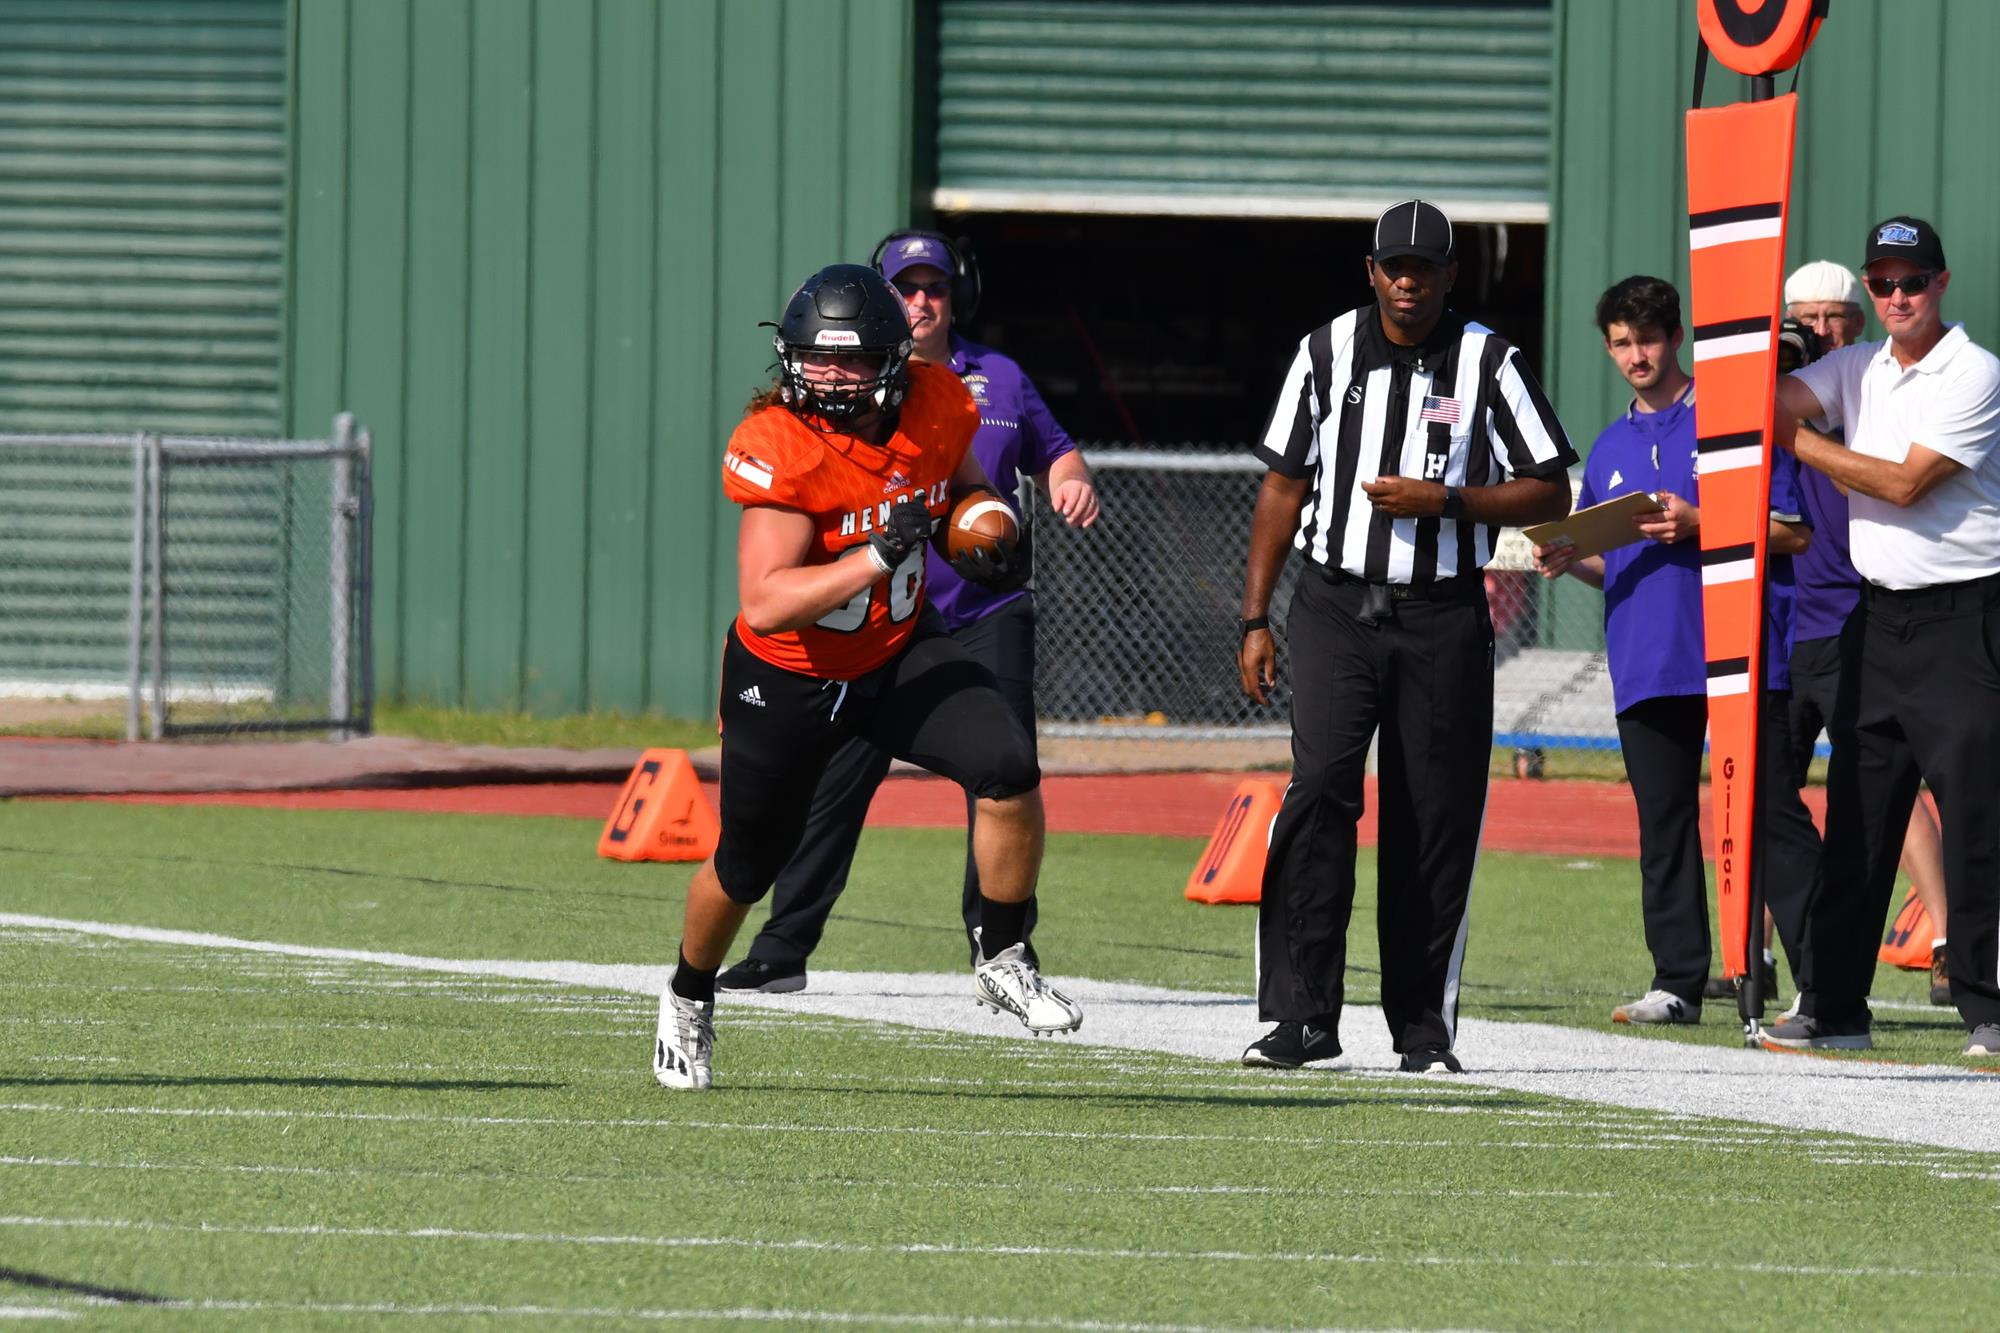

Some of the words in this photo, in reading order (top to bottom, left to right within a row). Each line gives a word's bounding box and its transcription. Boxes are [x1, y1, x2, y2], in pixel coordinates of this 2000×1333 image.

[1424, 453, 1447, 479] H
[840, 478, 949, 536] HENIX
[739, 693, 766, 707] adidas
[1721, 757, 1735, 895] Gilman
